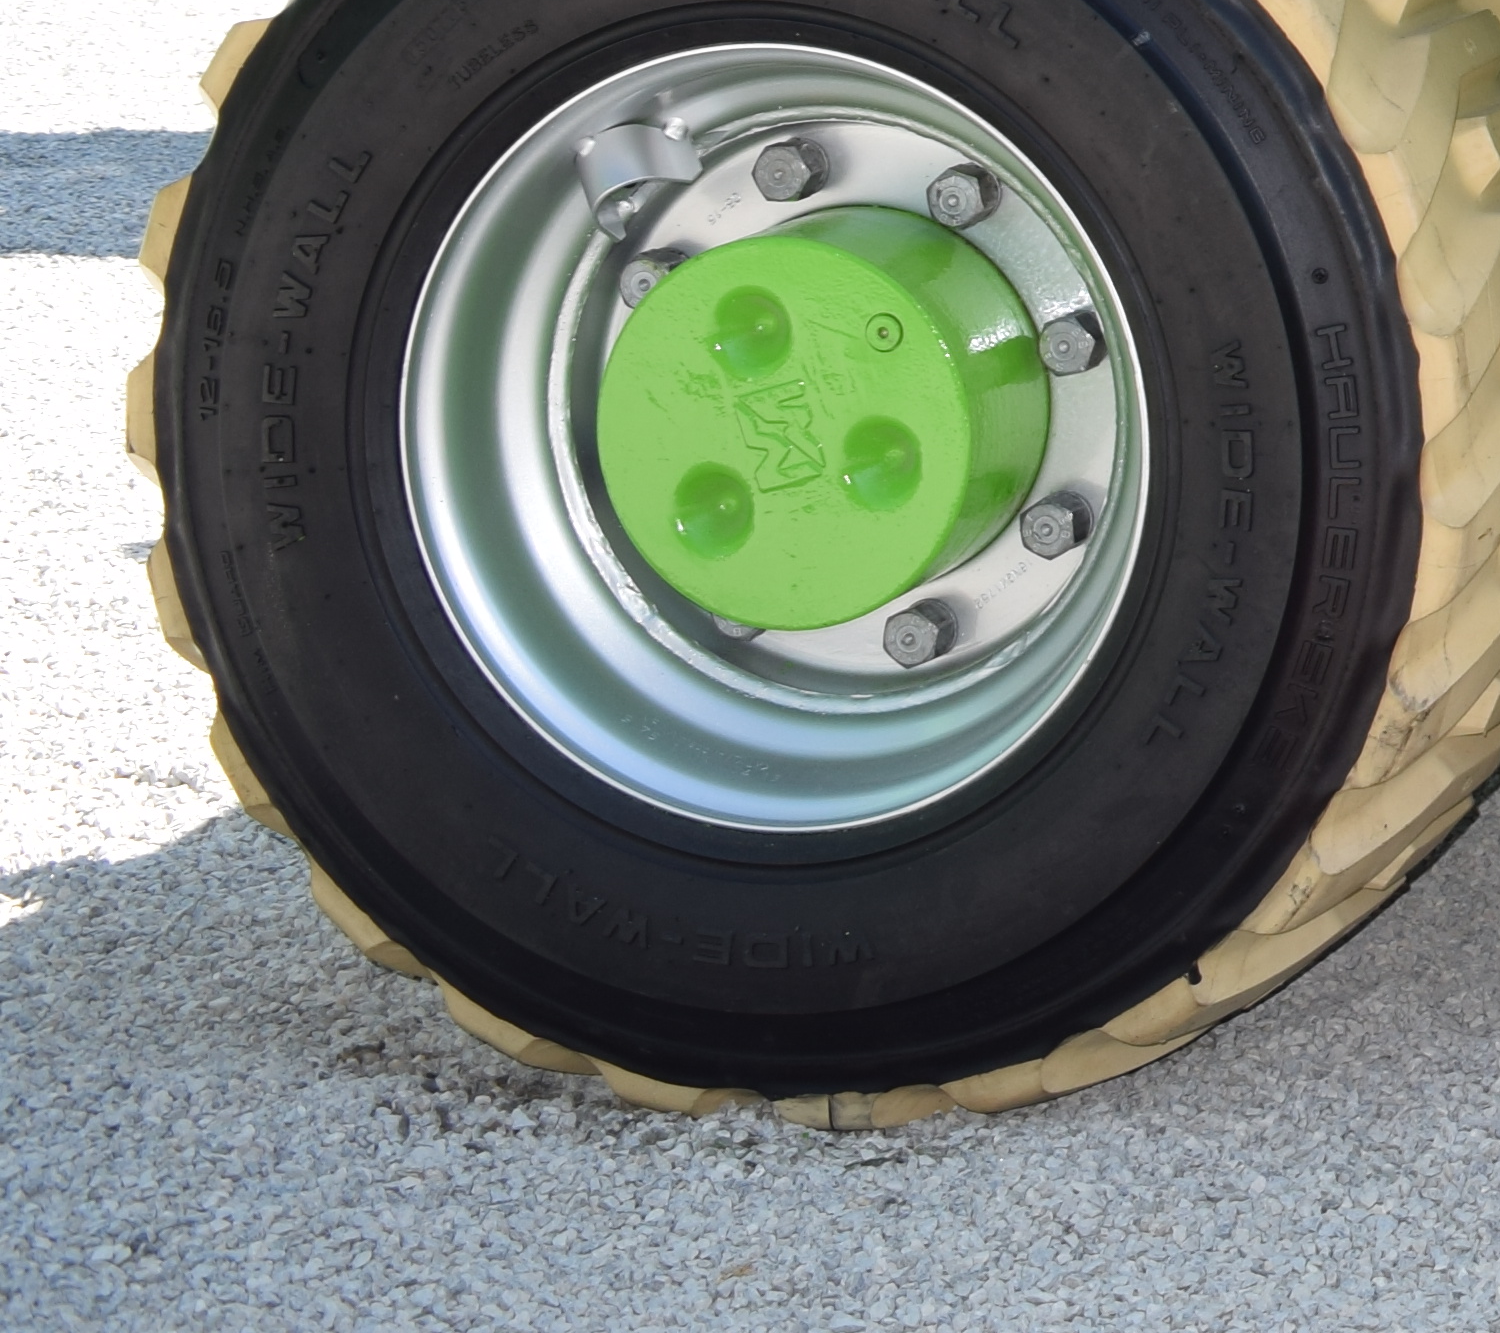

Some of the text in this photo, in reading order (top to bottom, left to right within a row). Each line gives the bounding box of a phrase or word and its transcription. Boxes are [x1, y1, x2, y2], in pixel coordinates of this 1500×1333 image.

[258, 146, 374, 554] WIDE-WALL
[1140, 339, 1254, 749] WIDE-WALL
[486, 837, 880, 973] WIDE-WALL
